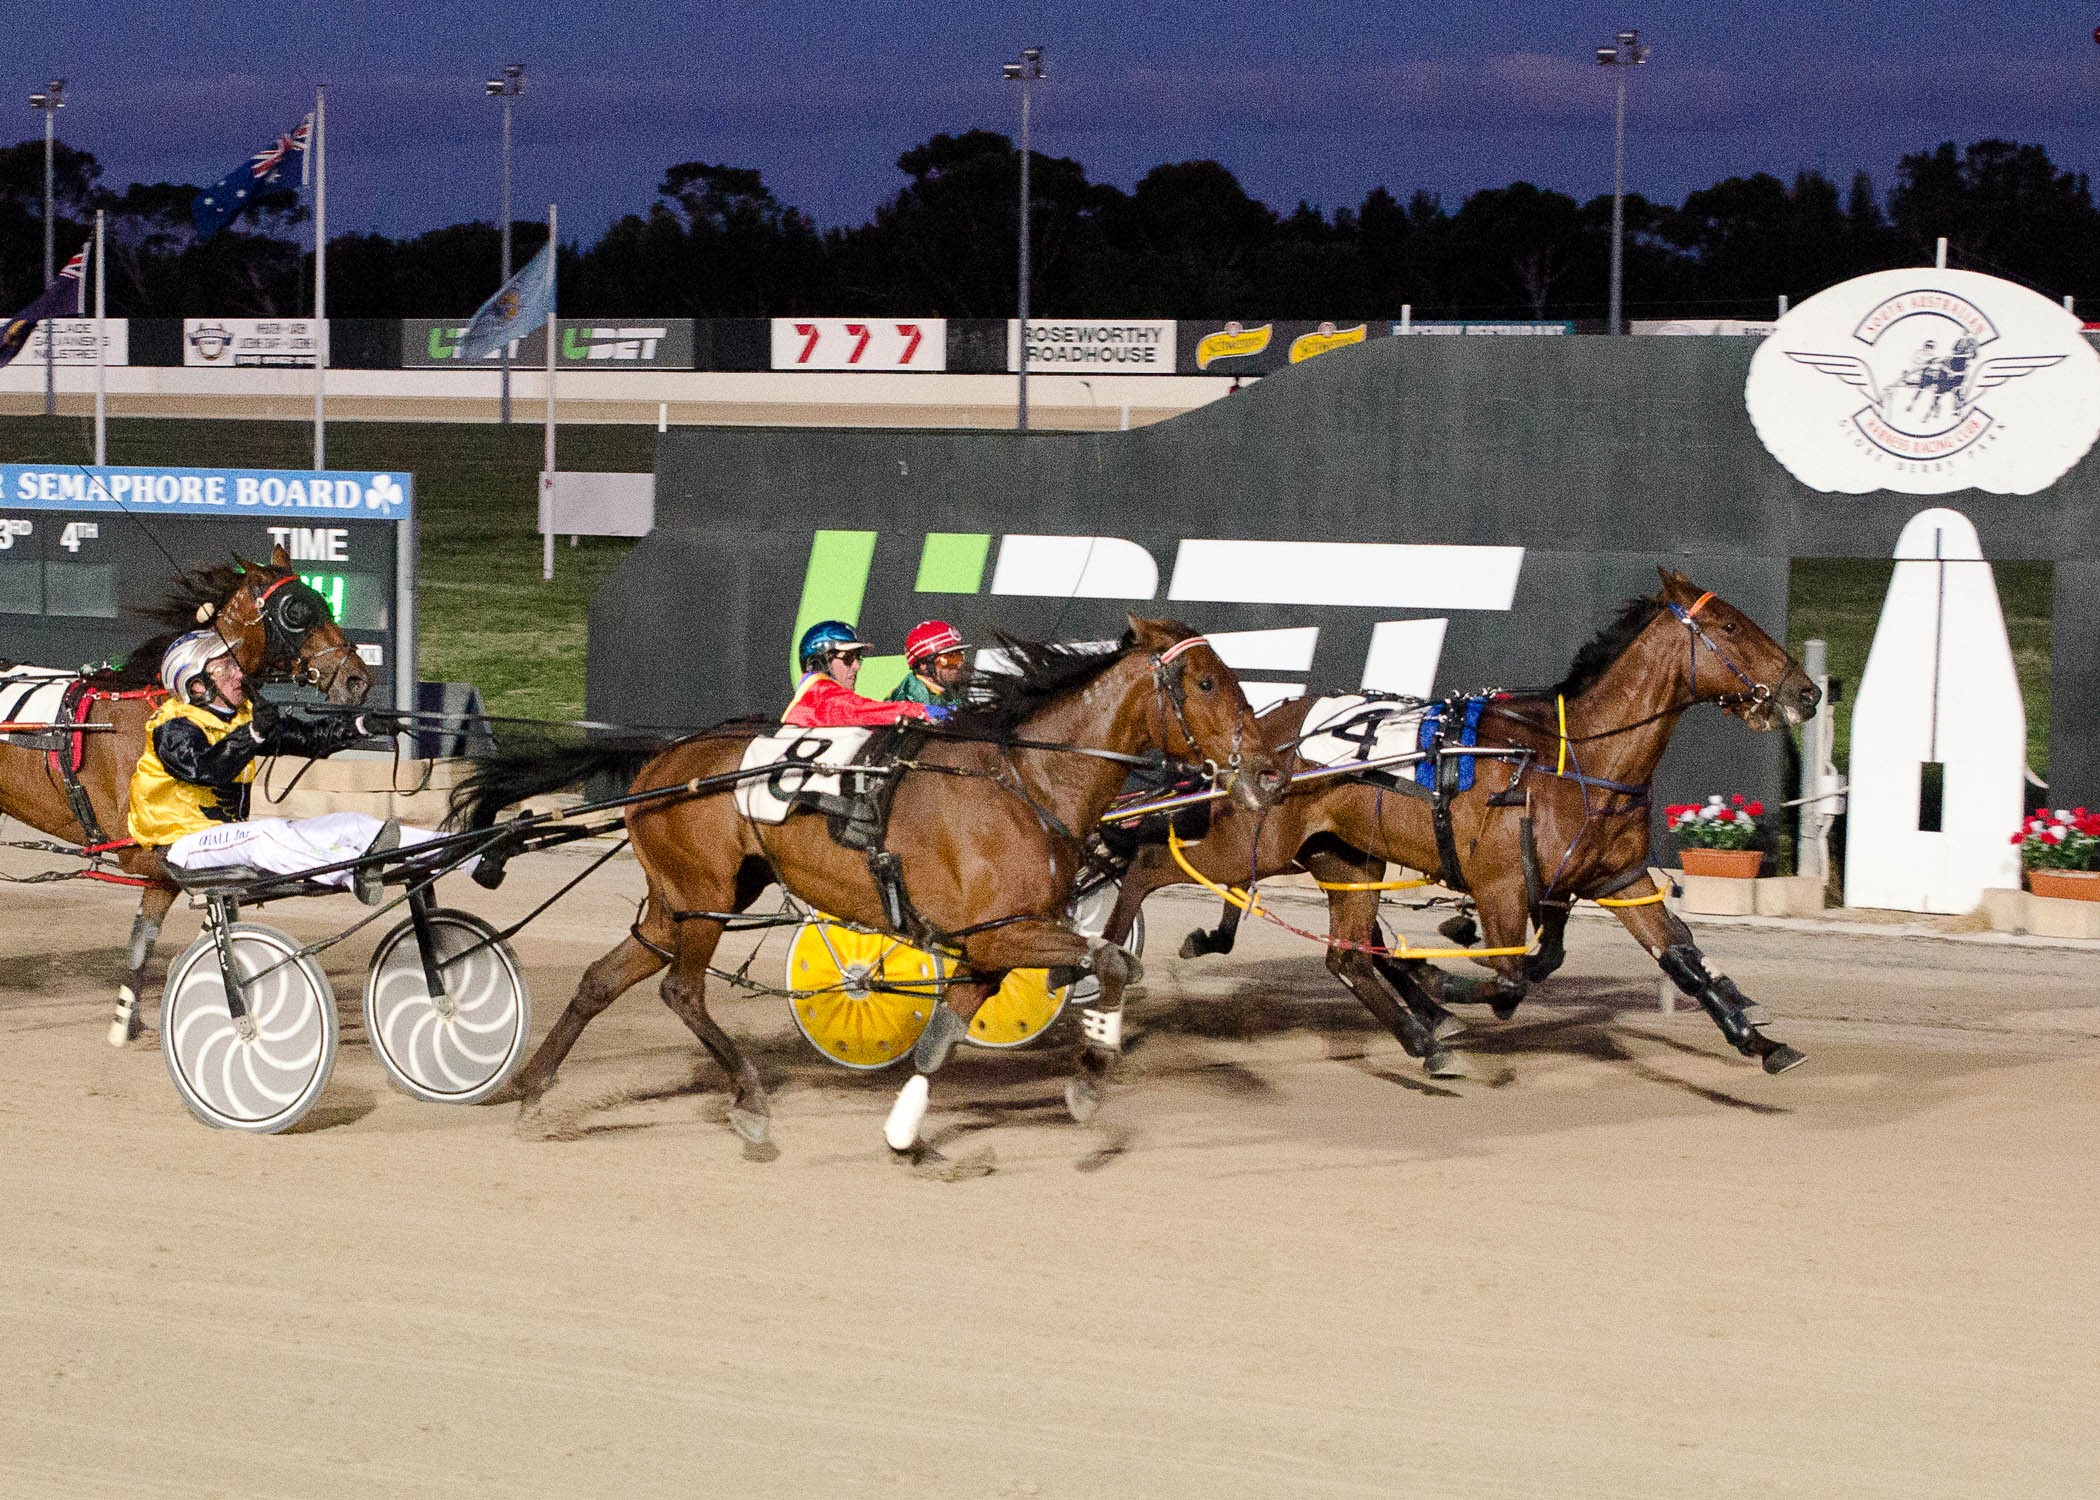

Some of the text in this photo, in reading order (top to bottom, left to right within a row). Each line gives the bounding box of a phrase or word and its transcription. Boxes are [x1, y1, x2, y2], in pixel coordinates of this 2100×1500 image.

[562, 327, 667, 360] UBET
[1027, 346, 1155, 363] ROADHOUSE
[17, 472, 227, 506] SEMAPHORE
[236, 477, 363, 510] BOARD
[267, 527, 350, 561] TIME
[1331, 708, 1395, 760] 4
[767, 737, 833, 803] 8
